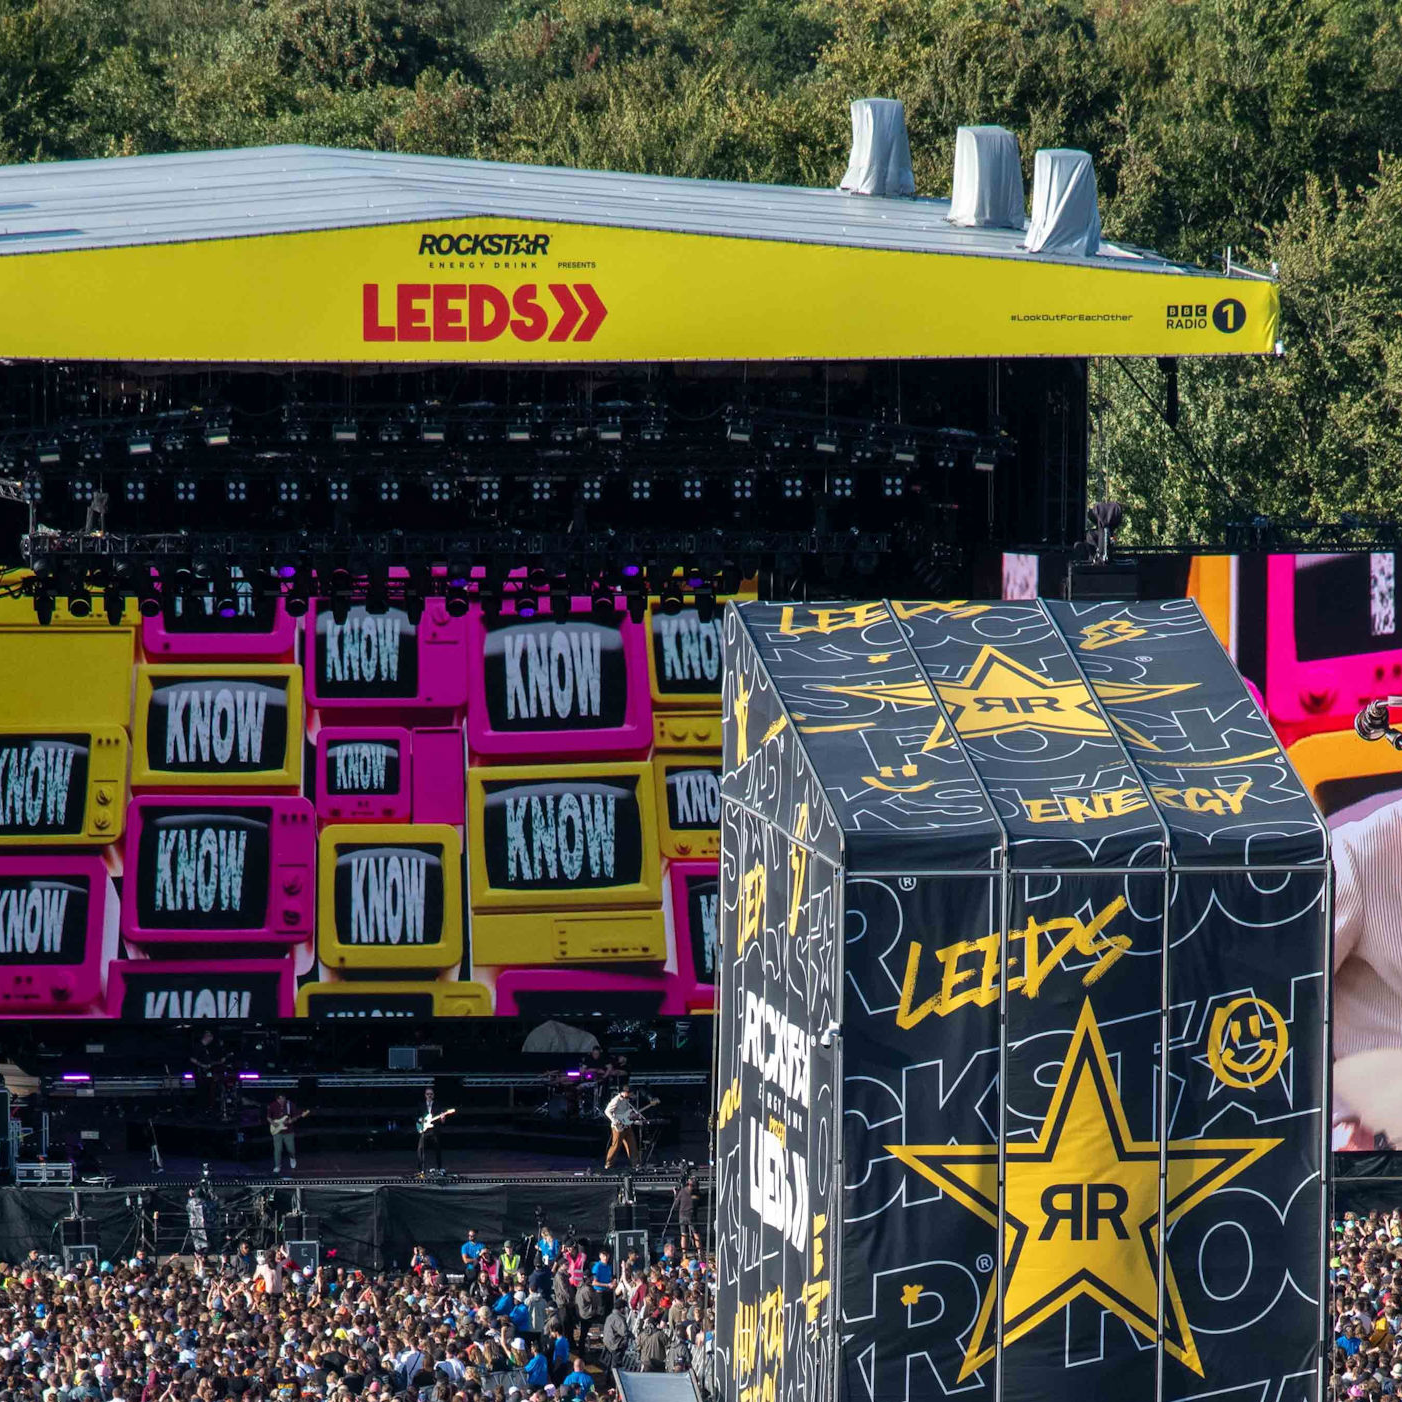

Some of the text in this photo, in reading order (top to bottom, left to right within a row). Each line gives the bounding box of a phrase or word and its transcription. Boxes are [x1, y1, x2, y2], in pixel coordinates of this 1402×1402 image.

[418, 234, 551, 255] ROCKSTAR
[557, 261, 597, 269] PRESENTS
[363, 284, 549, 342] LEEDS
[1166, 318, 1208, 330] RADIO
[1167, 305, 1207, 317] BBC
[326, 617, 399, 683] KNOW
[504, 631, 601, 720] KNOW
[661, 617, 724, 682] KNO
[165, 689, 267, 765] KNOW
[335, 744, 387, 791] KNOW
[675, 774, 722, 825] KNO
[1023, 781, 1254, 824] ENERGY
[506, 792, 617, 882] KNOW
[155, 828, 247, 912] KNOW
[350, 856, 426, 945] KNOW
[895, 895, 1134, 1031] LEEDS
